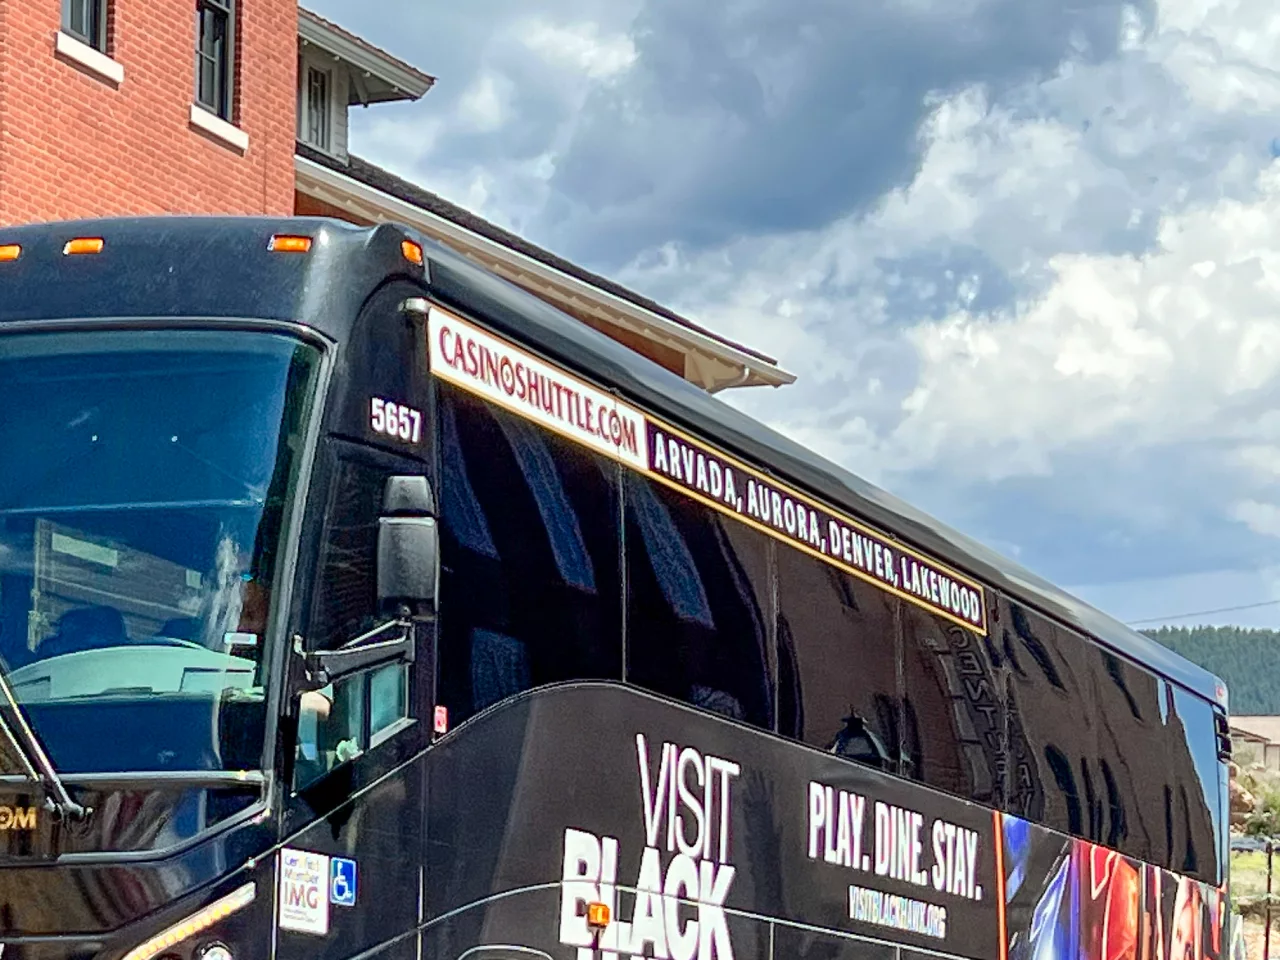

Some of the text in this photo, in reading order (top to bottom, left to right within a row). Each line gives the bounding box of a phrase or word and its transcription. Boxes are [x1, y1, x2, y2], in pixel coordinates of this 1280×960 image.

[371, 397, 421, 443] 5657
[438, 326, 638, 456] CASINOSHUTTLE.COM
[655, 432, 980, 622] ARVADA, AURORA, DENVER, LAKEWOOD
[636, 734, 740, 862] VISIT
[809, 781, 982, 900] PLAY. DINE. STAY.
[284, 881, 320, 909] IMG
